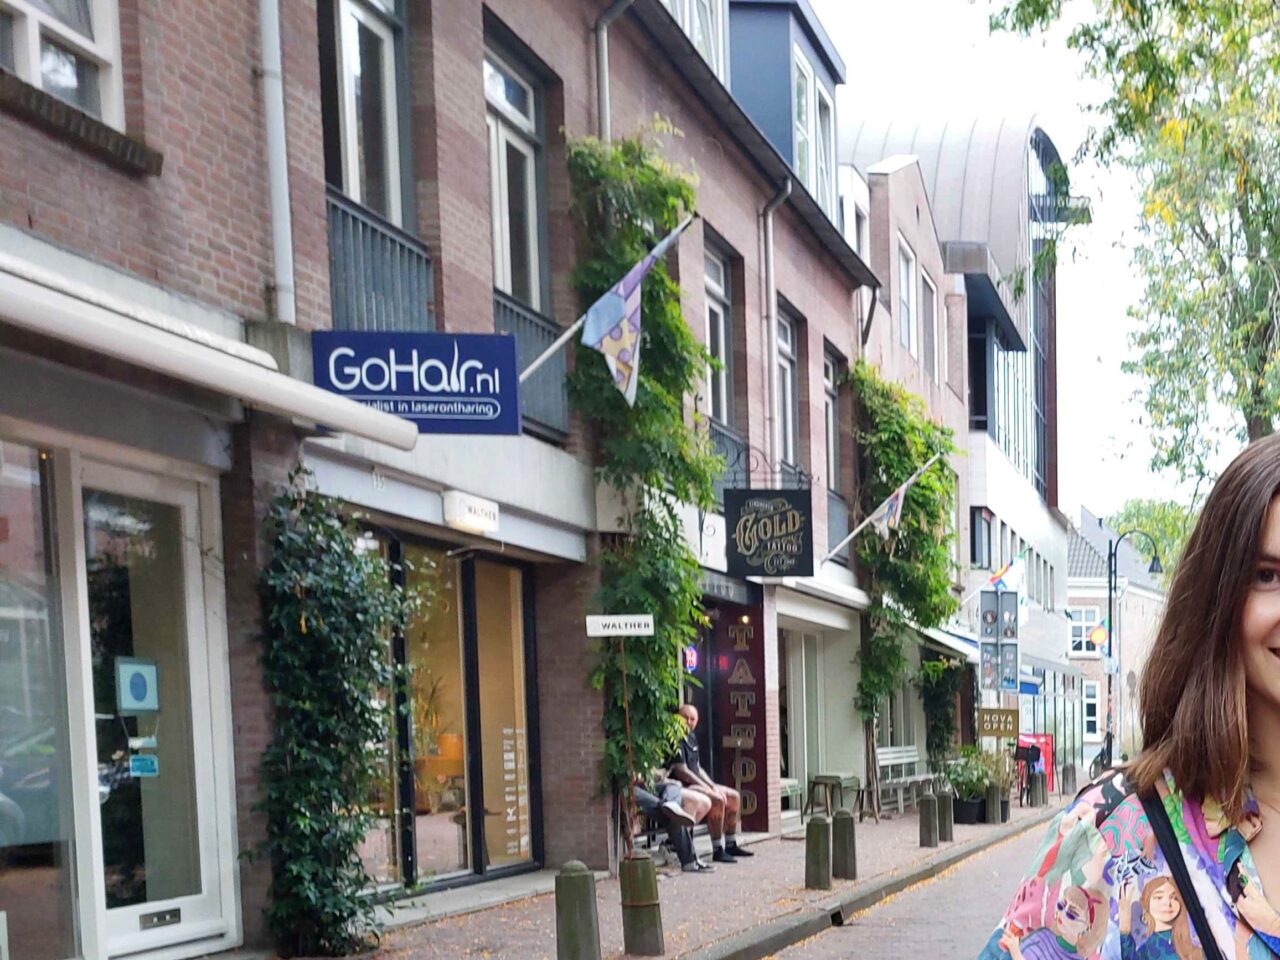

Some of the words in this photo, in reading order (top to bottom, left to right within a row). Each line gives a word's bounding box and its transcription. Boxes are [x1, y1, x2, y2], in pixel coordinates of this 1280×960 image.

[398, 401, 408, 411] in
[411, 401, 494, 416] laserontharing
[735, 509, 801, 556] GOLD
[601, 621, 650, 631] WALTHER
[983, 714, 1013, 722] NOVA
[983, 722, 1013, 731] OPEN
